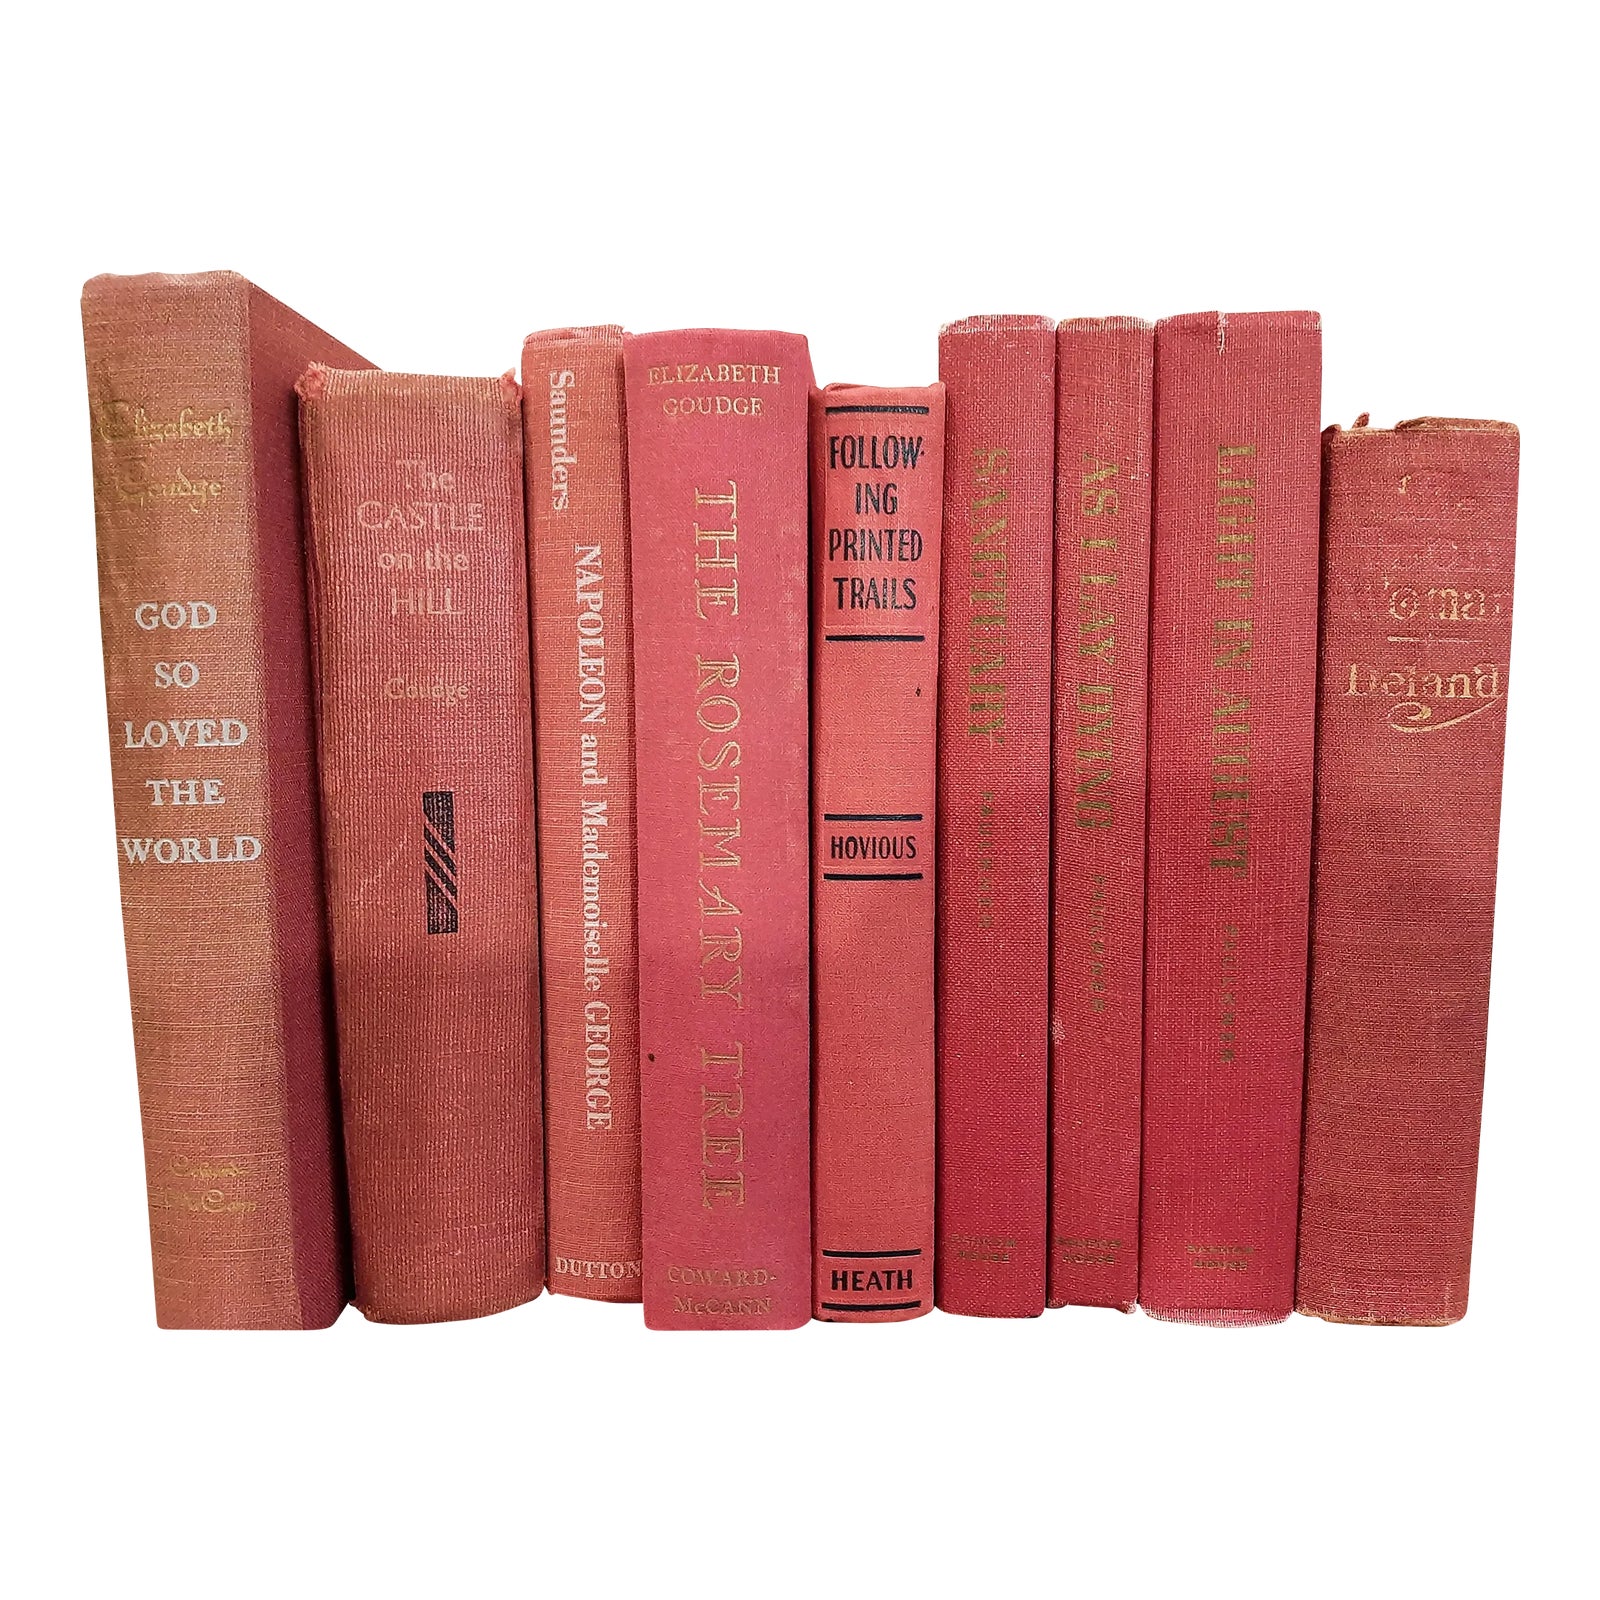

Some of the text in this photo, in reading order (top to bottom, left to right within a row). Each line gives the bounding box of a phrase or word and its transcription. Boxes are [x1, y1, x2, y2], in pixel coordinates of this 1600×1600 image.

[648, 364, 780, 386] ELIZABETH
[663, 396, 765, 417] GOUDGE
[549, 369, 577, 511] Saunders
[829, 435, 925, 470] FOLLOW-
[855, 482, 898, 515] ING
[357, 500, 484, 531] CASTLE
[378, 543, 470, 571] on the
[828, 528, 923, 562] PRINTED
[391, 588, 464, 616] HILL
[833, 576, 917, 610] TRAILS
[135, 600, 217, 630] GOD
[1074, 453, 1120, 829] AS I LAY DYING
[1212, 619, 1254, 668] IN
[154, 661, 200, 688] SO
[124, 718, 248, 749] LOVED
[145, 778, 226, 806] THE
[122, 835, 263, 864] WORLD
[574, 543, 612, 1131] NAPOLEON and Mademoiselle GEORGE
[694, 480, 745, 1210] THE ROSEMARY TREE
[830, 834, 918, 860] HOVIOUS
[555, 1257, 641, 1279] DUTTON
[831, 1269, 913, 1292] HEATH
